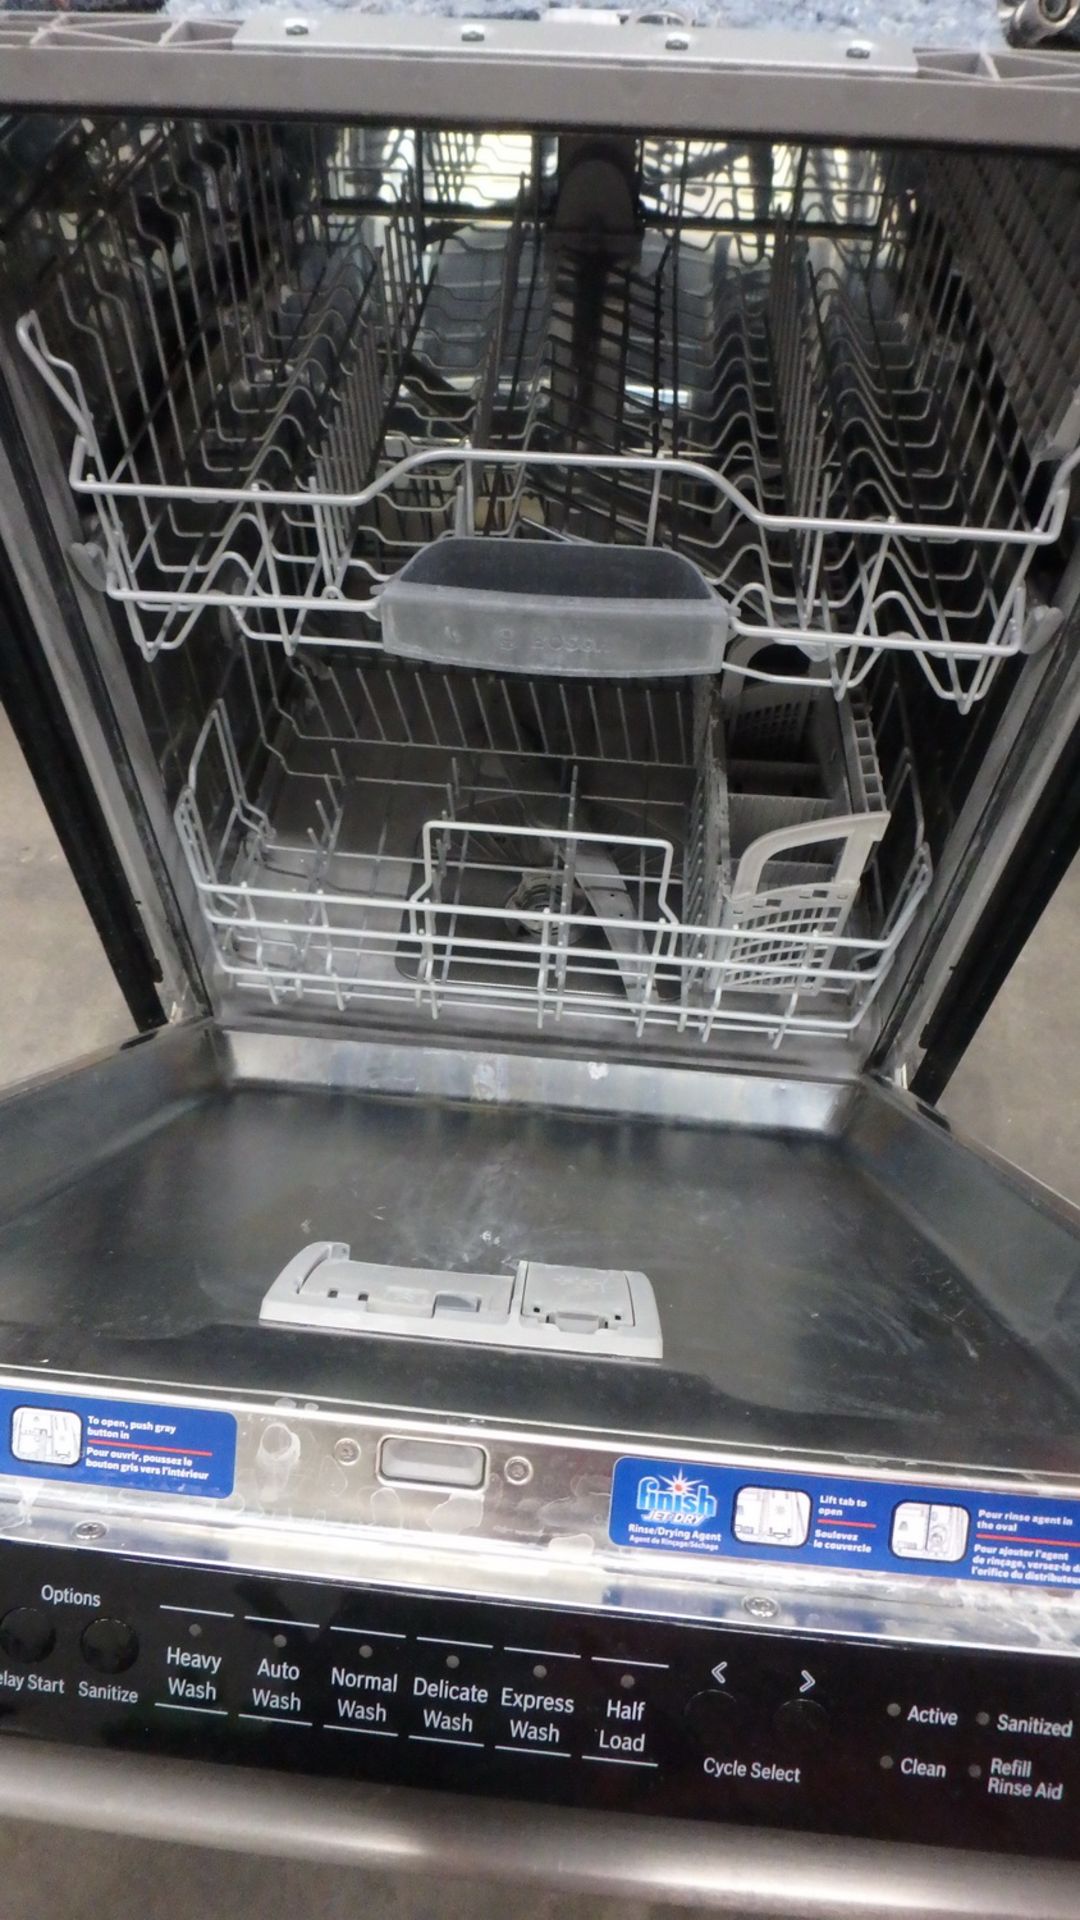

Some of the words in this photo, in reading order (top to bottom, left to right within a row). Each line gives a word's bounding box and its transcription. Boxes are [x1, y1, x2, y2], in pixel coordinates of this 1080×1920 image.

[87, 1415, 99, 1425] To
[101, 1418, 129, 1429] open,
[130, 1421, 153, 1431] push
[155, 1425, 176, 1434] gray
[87, 1427, 119, 1438] button
[120, 1430, 130, 1439] in
[86, 1447, 109, 1457] Pour
[110, 1451, 141, 1462] ouvrir,
[143, 1454, 182, 1465] poussez
[183, 1457, 193, 1467] le
[85, 1458, 119, 1470] bouton
[121, 1463, 139, 1472] gris
[140, 1466, 161, 1474] vers
[162, 1466, 209, 1480] l'intérieur
[636, 1476, 717, 1518] finish
[820, 1495, 837, 1505] Lift
[838, 1498, 855, 1506] tab
[856, 1500, 868, 1508] to
[818, 1508, 843, 1516] open
[978, 1509, 1002, 1519] Pour
[1004, 1512, 1030, 1522] rinse
[1032, 1516, 1060, 1525] agent
[1062, 1516, 1073, 1526] in
[628, 1523, 691, 1540] Rinse/Drying
[692, 1530, 722, 1542] Agent
[815, 1529, 859, 1541] Soulevez
[977, 1521, 994, 1529] the
[995, 1523, 1017, 1532] oval
[813, 1539, 823, 1548] le
[824, 1542, 872, 1553] couvercle
[974, 1544, 997, 1553] Pour
[999, 1547, 1033, 1557] ajouter
[1035, 1549, 1069, 1561] l'agent
[971, 1566, 1009, 1578] l'orifice
[1010, 1571, 1023, 1580] du
[972, 1555, 985, 1564] de
[987, 1557, 1025, 1569] rinçage,
[1027, 1561, 1071, 1572] versez-le
[41, 1584, 101, 1607] Options
[166, 1646, 222, 1674] Heavy
[257, 1658, 300, 1680] Auto
[27, 1674, 65, 1694] Start
[168, 1677, 217, 1701] Wash
[331, 1667, 398, 1693] Normal
[413, 1677, 489, 1703] Delicate
[78, 1681, 139, 1703] Sanitize
[252, 1688, 301, 1711] Wash
[501, 1687, 575, 1713] Express
[337, 1698, 387, 1722] Wash
[423, 1709, 473, 1732] Wash
[607, 1699, 646, 1721] Half
[907, 1706, 958, 1726] Active
[510, 1719, 560, 1743] Wash
[996, 1714, 1073, 1738] Sanitized
[599, 1730, 646, 1752] Load
[703, 1757, 747, 1778] Cycle
[750, 1761, 800, 1783] Select
[900, 1758, 947, 1778] Clean
[990, 1758, 1032, 1777] Refill
[987, 1777, 1033, 1798] Rinse
[1035, 1781, 1063, 1800] Aid
